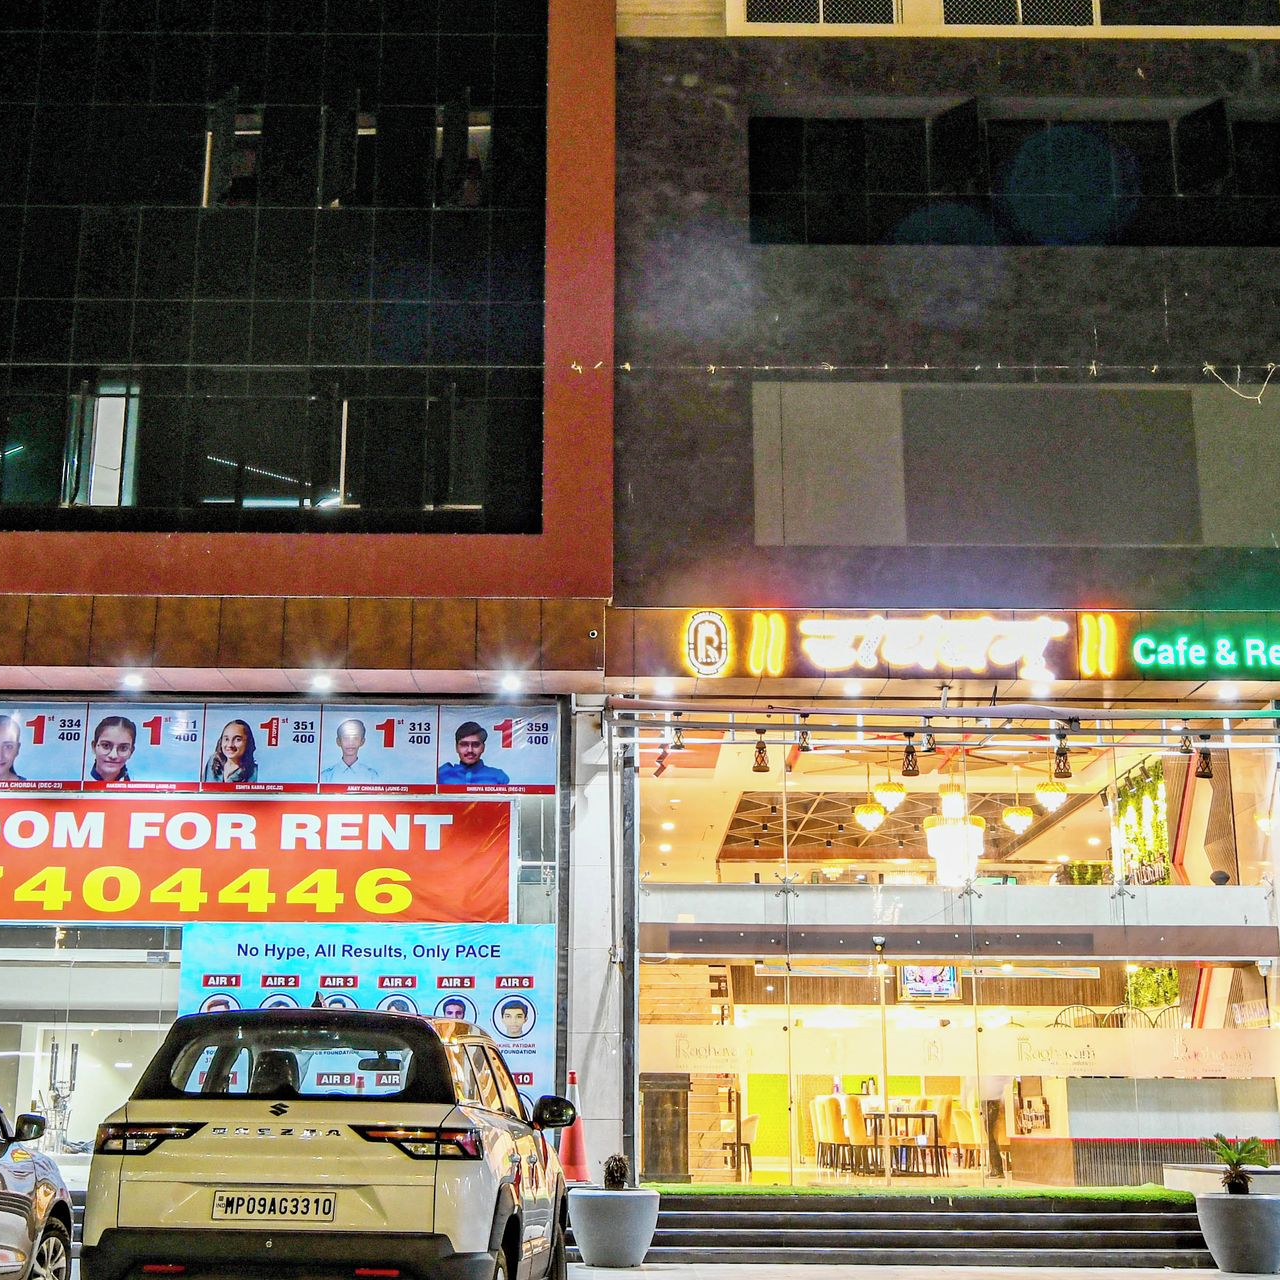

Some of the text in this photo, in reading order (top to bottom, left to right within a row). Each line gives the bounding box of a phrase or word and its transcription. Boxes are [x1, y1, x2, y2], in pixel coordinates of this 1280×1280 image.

[1133, 636, 1206, 666] Cafe
[1215, 638, 1237, 665] &
[59, 719, 81, 729] 334
[293, 721, 313, 730] 351
[409, 722, 431, 732] 313
[527, 722, 549, 732] 359
[58, 731, 80, 741] 400
[175, 733, 197, 742] 400
[293, 734, 314, 743] 400
[408, 735, 431, 745] 400
[526, 736, 549, 745] 400
[128, 812, 257, 850] FOR
[280, 814, 453, 851] RENT
[237, 944, 501, 961] No Hype, All Results, Only PACE
[207, 977, 236, 985] AIR 1
[266, 978, 295, 986] AIR 2
[324, 978, 354, 986] AIR 3
[382, 978, 412, 986] AIR 4
[441, 978, 470, 986] AIR 5
[500, 978, 529, 986] AIR 6
[321, 1075, 351, 1083] AIR 8
[380, 1075, 400, 1083] AIR
[518, 1075, 530, 1083] 10
[225, 1197, 331, 1215] MP09AG3310
